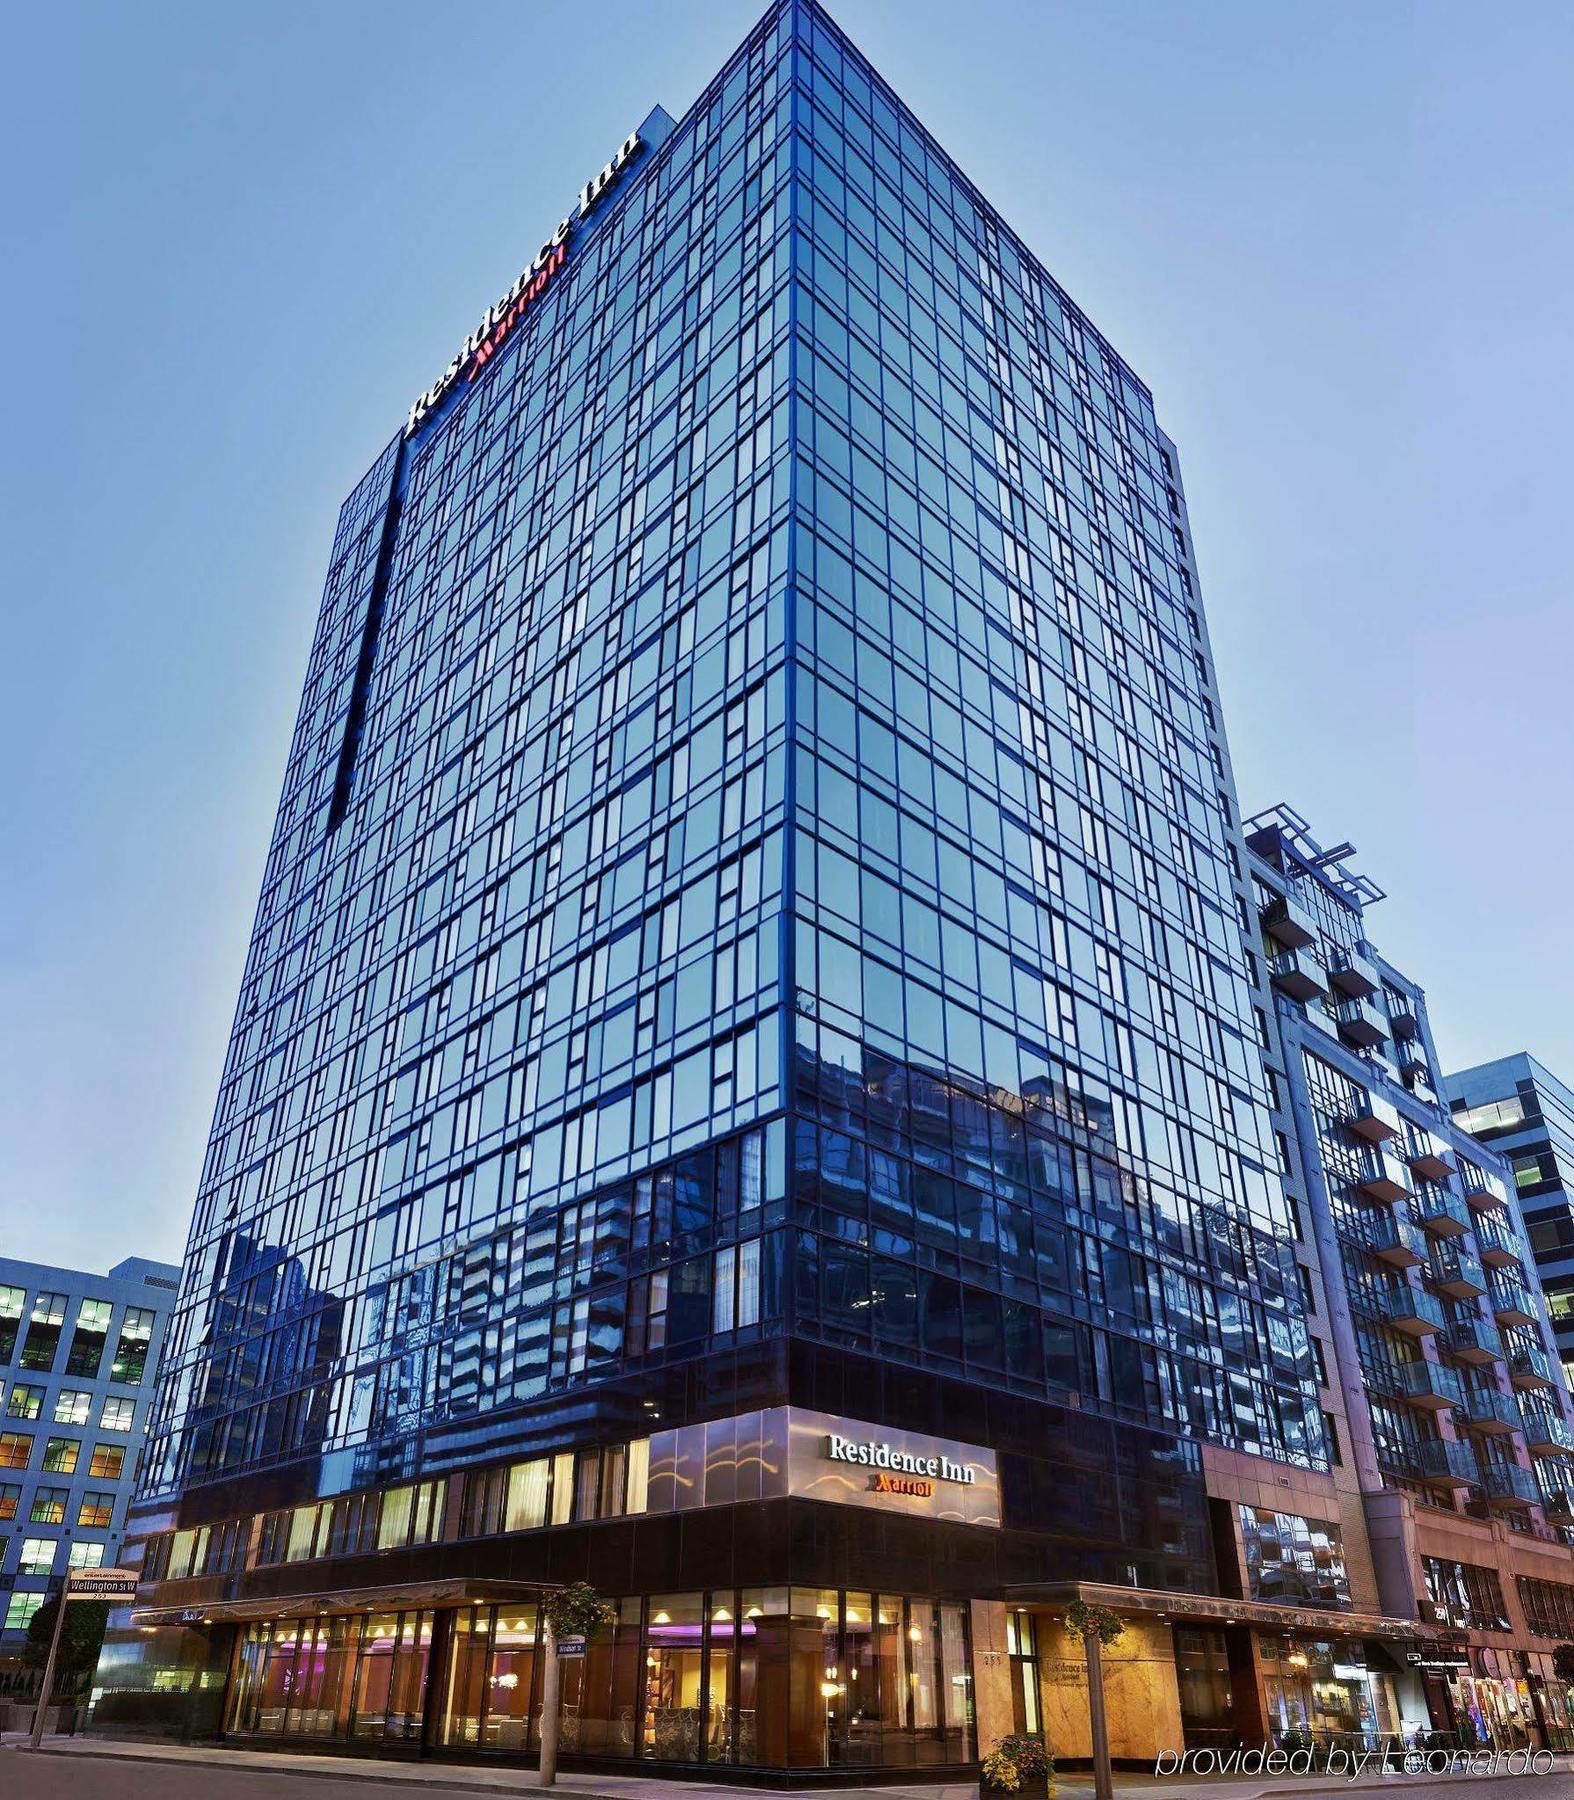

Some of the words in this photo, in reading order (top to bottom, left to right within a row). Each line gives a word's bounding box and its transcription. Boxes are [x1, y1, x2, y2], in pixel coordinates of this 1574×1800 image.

[404, 217, 570, 440] Residence
[577, 131, 640, 218] Inn
[829, 1434, 938, 1478] Residence
[941, 1456, 976, 1485] Inn
[71, 1580, 118, 1593] Wellington
[127, 1581, 135, 1591] W
